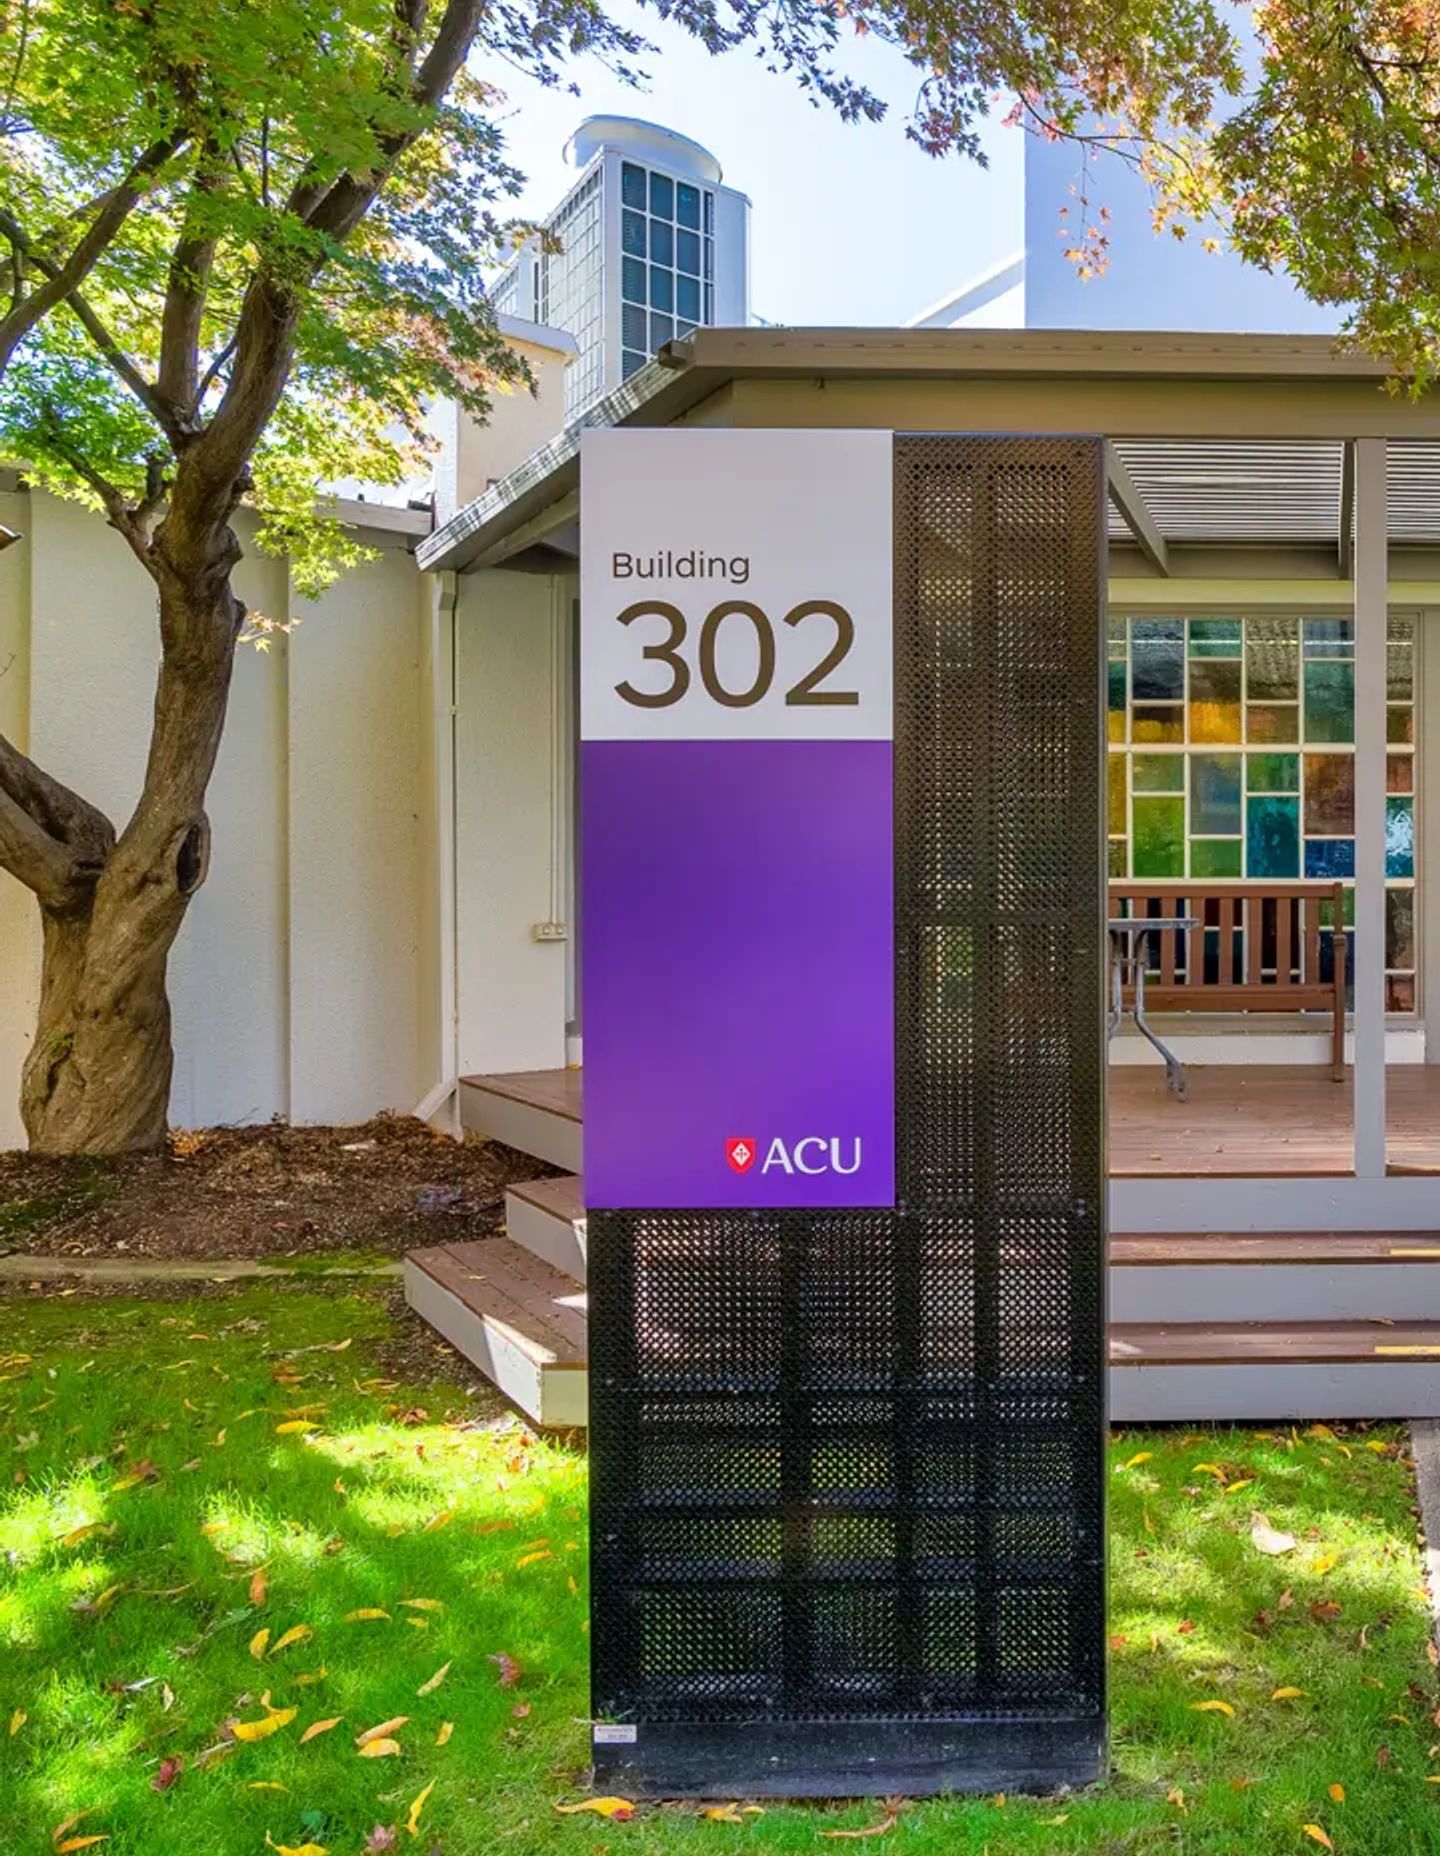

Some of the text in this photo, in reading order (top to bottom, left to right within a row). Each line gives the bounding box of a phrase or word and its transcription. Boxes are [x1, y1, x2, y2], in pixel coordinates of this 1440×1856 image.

[612, 551, 750, 584] Building
[613, 599, 860, 709] 302
[761, 1136, 862, 1175] ACU
